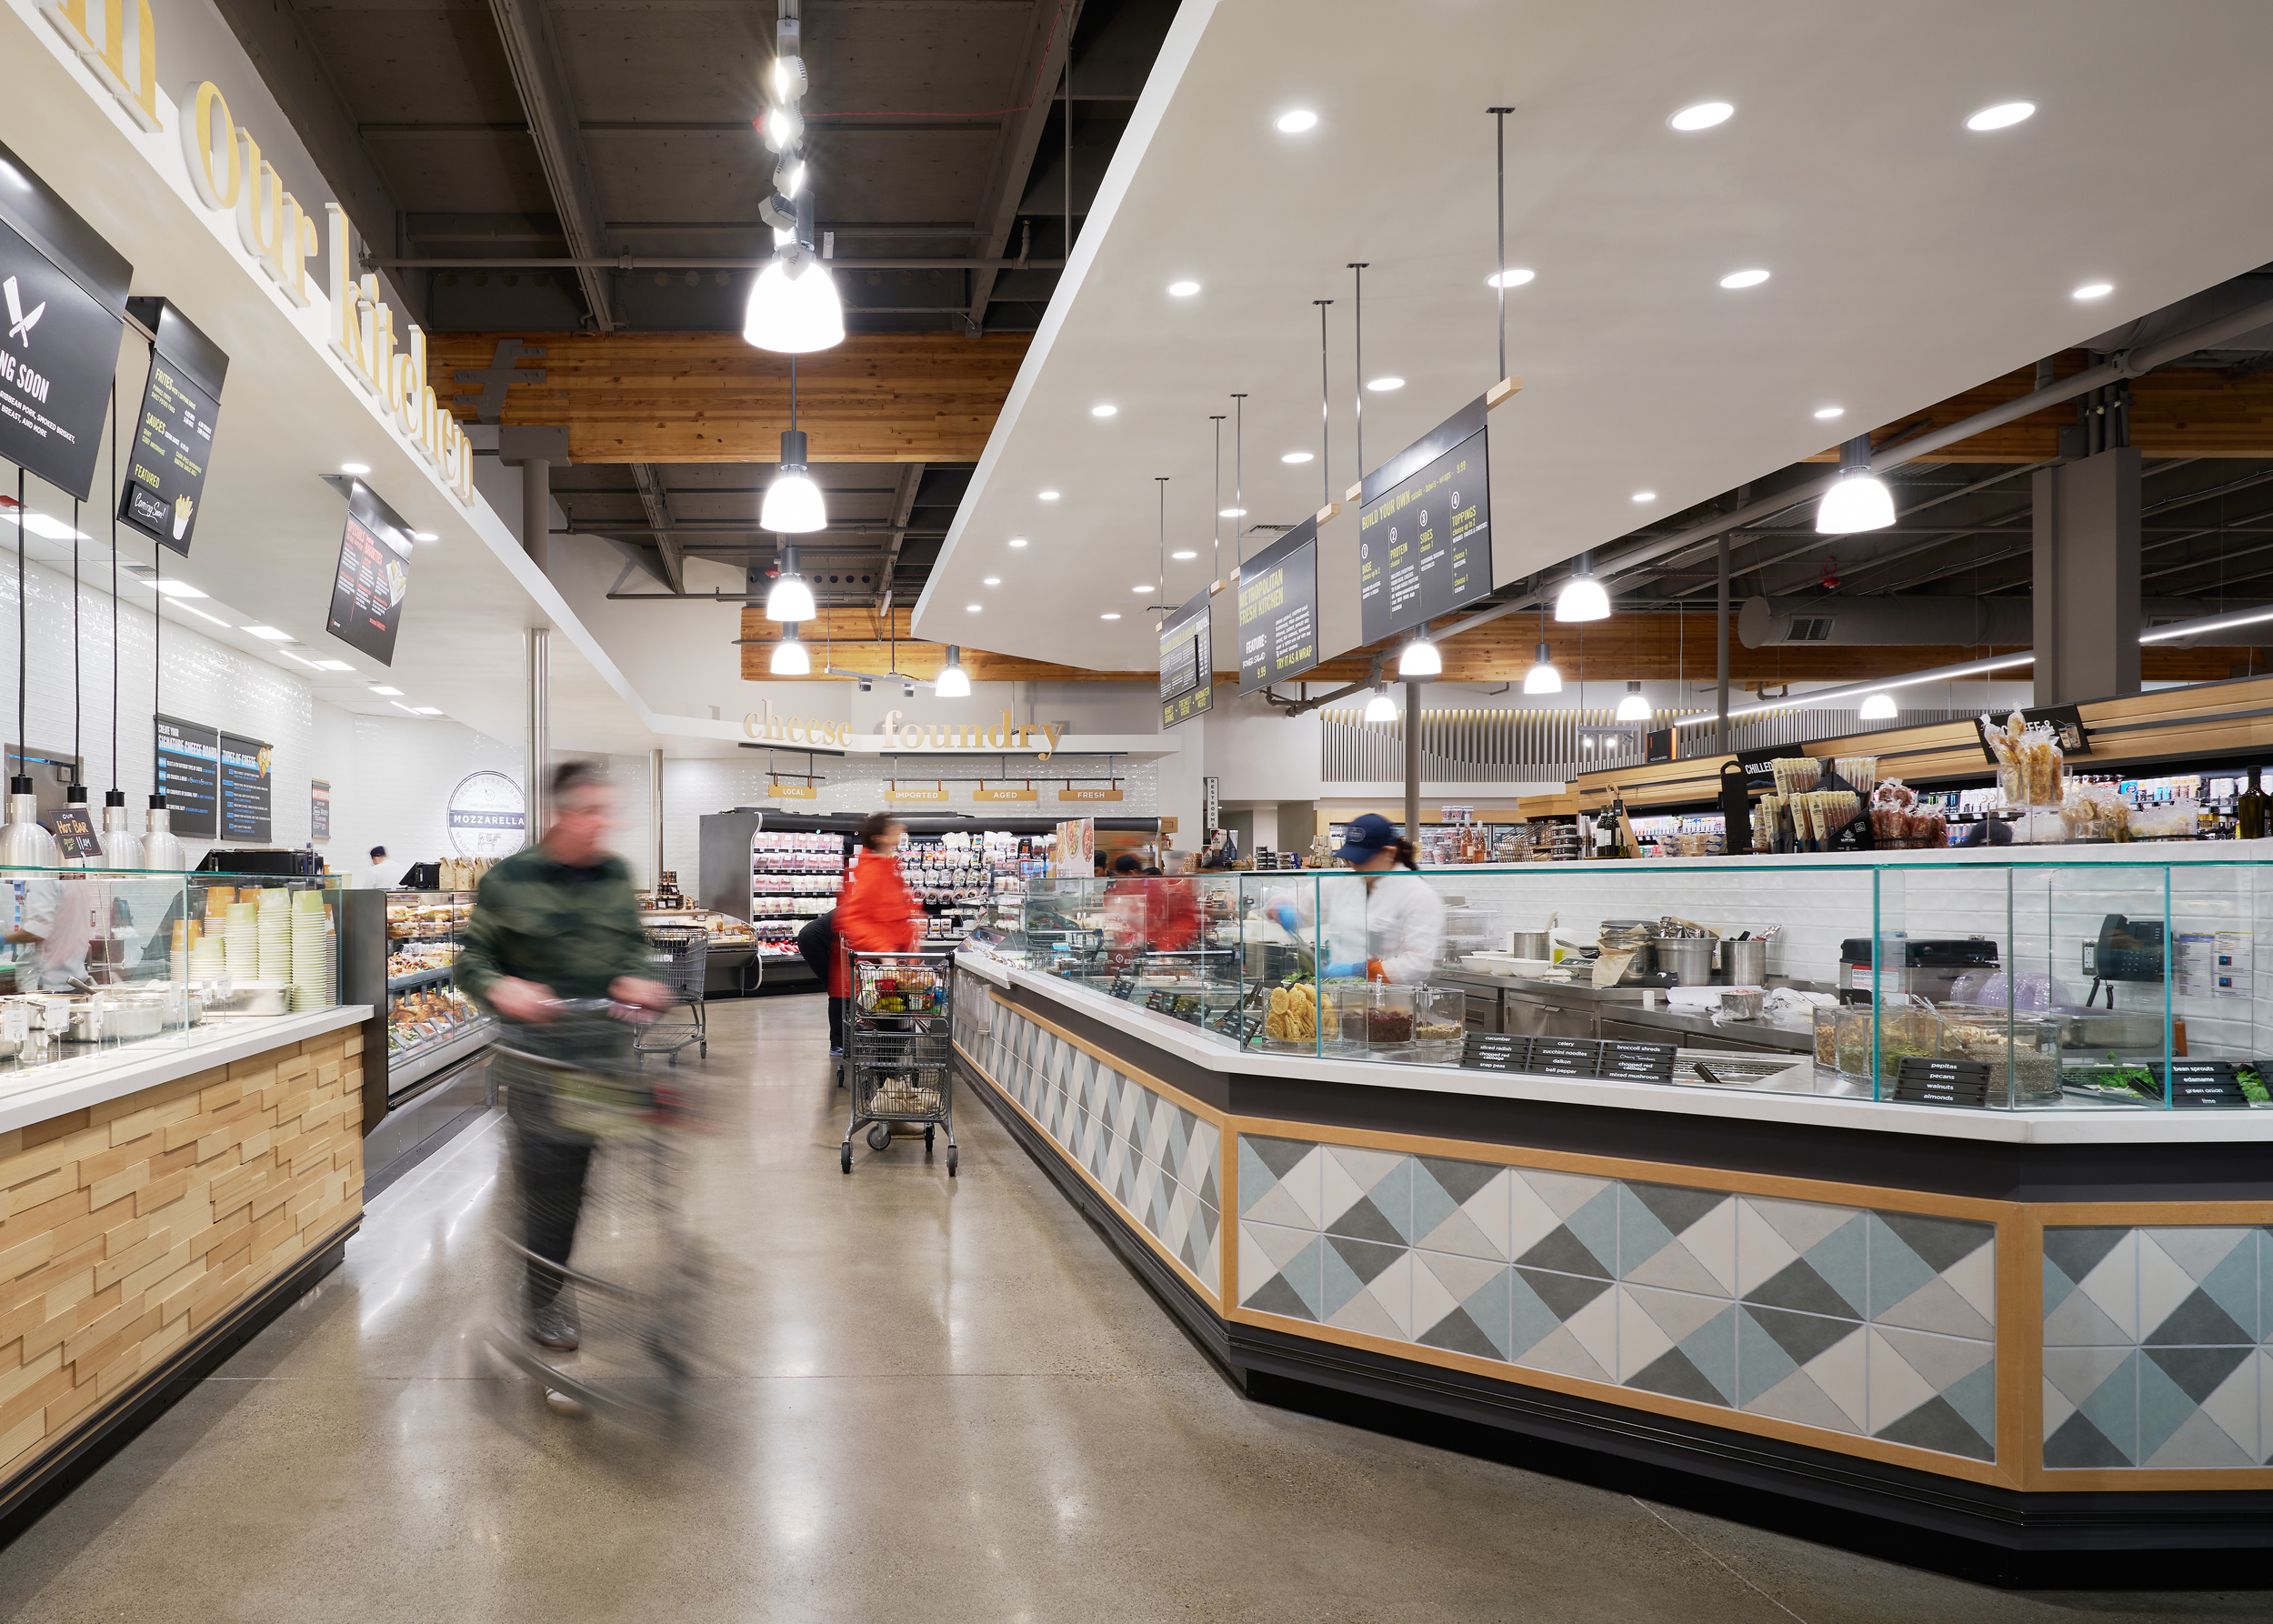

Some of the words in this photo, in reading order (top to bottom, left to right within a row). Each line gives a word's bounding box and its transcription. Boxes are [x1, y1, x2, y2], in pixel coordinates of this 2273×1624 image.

[181, 80, 318, 308] our
[325, 202, 476, 508] kitchen
[16, 364, 50, 404] SOON
[155, 367, 173, 390] FRITES
[151, 392, 160, 401] SWEET
[159, 396, 168, 408] POTATO
[1, 405, 21, 423] BREAST,
[21, 417, 34, 429] AND
[34, 424, 47, 438] MORE
[22, 405, 36, 420] PORK,
[37, 415, 56, 431] SMOKED
[56, 426, 75, 444] BRISKET,
[146, 412, 165, 435] SAUCES
[135, 464, 160, 489] FEATURED
[1361, 509, 1378, 531] BUILD
[1379, 499, 1396, 520] YOUR
[1396, 489, 1410, 509] OWN
[1411, 488, 1423, 501] salads
[1439, 472, 1451, 484] wraps
[1457, 460, 1466, 474] 9.99
[135, 493, 153, 516] Coming
[152, 502, 166, 519] Soon!
[1452, 505, 1476, 526] TOPPINGS
[1420, 528, 1433, 545] SIDES
[1453, 526, 1464, 536] choose
[1464, 529, 1473, 538] FRUITS
[1390, 542, 1407, 559] PROTEIN
[1420, 543, 1430, 553] choose
[1454, 551, 1465, 561] choose
[1362, 561, 1372, 575] BASE
[1240, 567, 1283, 609] METROPOLITAN
[1455, 576, 1466, 586] choose
[1240, 603, 1257, 627] FRESH
[1258, 587, 1283, 617] KITCHEN
[1392, 604, 1402, 612] CHICKEN
[1246, 634, 1267, 654] FEATURE:
[1285, 655, 1288, 667] IT
[1288, 653, 1295, 665] AS
[1296, 650, 1298, 662] A
[1299, 645, 1312, 660] WRAP
[1257, 666, 1267, 678] 9.99
[1196, 687, 1209, 700] MARINATED
[1165, 705, 1174, 716] HEARTY
[1181, 705, 1190, 717] GREENS
[1197, 697, 1207, 708] MEATS
[1165, 713, 1174, 724] GRAINS
[158, 724, 171, 735] CREATE
[171, 727, 179, 737] YOUR
[744, 699, 854, 747] cheese
[882, 709, 1065, 761] foundry
[158, 735, 184, 752] SIGNATURE
[185, 740, 202, 757] CHEESE
[203, 745, 216, 759] BOARD
[223, 750, 235, 765] TYPES
[236, 752, 241, 765] OF
[242, 753, 256, 768] CHEESE
[1745, 761, 1774, 775] CHILLED
[457, 780, 477, 802] FRESH
[481, 778, 521, 805] STRETCHED
[783, 787, 805, 797] LOCAL
[896, 791, 938, 799] IMPORTED
[993, 791, 1017, 799] AGED
[1077, 791, 1106, 799] FRESH
[454, 815, 525, 826] MOZZARELLA
[456, 831, 470, 852] MADE
[508, 834, 523, 854] DAILY
